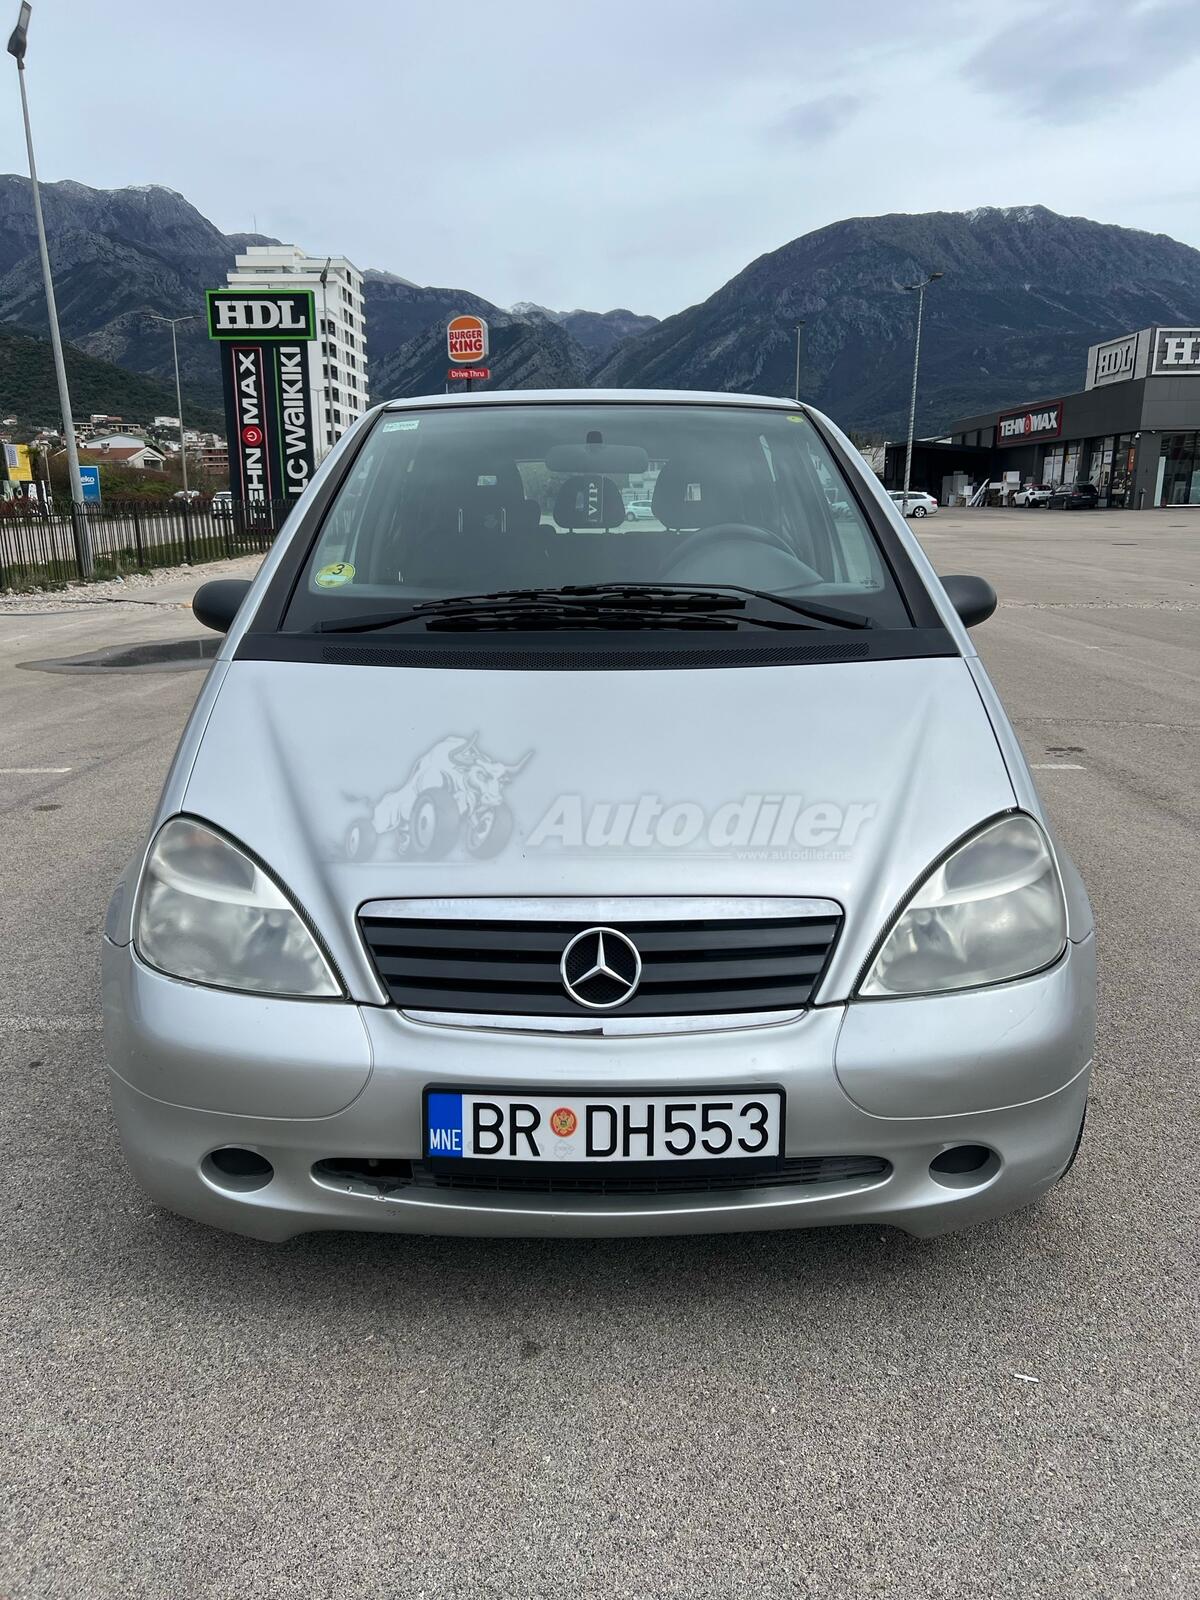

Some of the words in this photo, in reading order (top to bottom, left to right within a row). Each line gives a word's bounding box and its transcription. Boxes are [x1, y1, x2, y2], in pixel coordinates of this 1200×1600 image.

[214, 300, 306, 329] HDL
[449, 330, 482, 340] BURGER
[449, 339, 483, 353] KING
[1099, 345, 1133, 377] HDL
[451, 370, 468, 378] Drive
[80, 475, 95, 483] eko
[287, 458, 309, 493] LC
[332, 564, 345, 575] 3
[429, 1129, 462, 1151] MNE
[472, 1102, 541, 1157] BR
[585, 1102, 769, 1157] DH553
